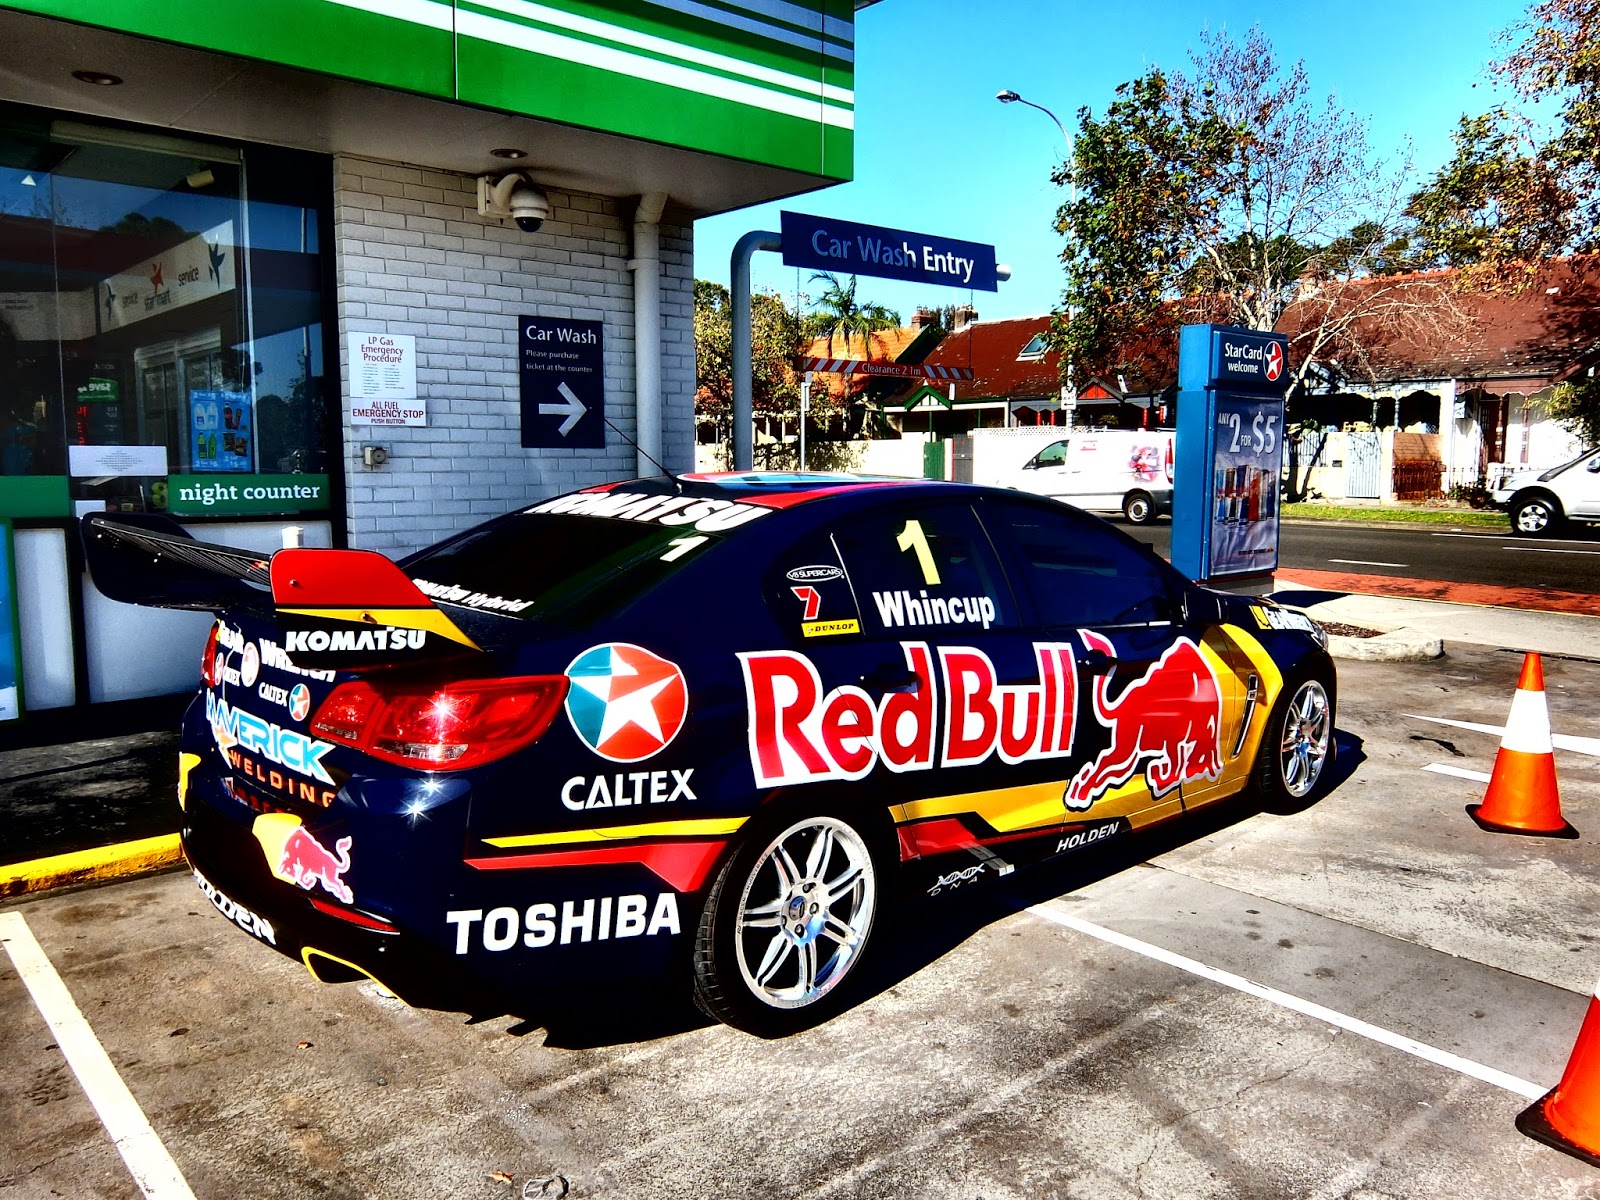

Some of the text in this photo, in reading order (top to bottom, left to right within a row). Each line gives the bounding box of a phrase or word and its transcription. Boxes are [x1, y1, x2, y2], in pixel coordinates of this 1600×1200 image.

[811, 228, 974, 283] Car Wash Entry
[178, 264, 199, 287] service
[368, 336, 394, 346] LP Gas
[525, 325, 597, 345] Car Wash
[361, 344, 404, 357] Emergency
[363, 353, 402, 364] Procedure
[526, 349, 580, 360] Please purchase
[1224, 342, 1263, 361] StarCard
[526, 363, 545, 371] ticket
[555, 364, 566, 372] the
[567, 365, 593, 373] counter
[861, 362, 901, 375] Clearance
[1227, 360, 1259, 373] welcome
[352, 408, 424, 419] EMERGENCY STOP
[371, 401, 399, 410] ALL FUEL
[1217, 412, 1230, 425] ANY
[1229, 412, 1241, 453] 2
[1240, 434, 1252, 447] FOR
[179, 482, 321, 506] night counter
[523, 492, 773, 532] KOMATSU
[660, 536, 709, 563] 1
[896, 519, 942, 586] 1
[799, 568, 841, 579] SUPERCARS
[461, 592, 535, 613] Hybrid
[872, 589, 996, 630] Whincup
[286, 626, 426, 653] KOMATSU
[814, 623, 854, 633] DUNLOP
[258, 681, 289, 707] CALTEX
[735, 640, 1078, 789] Red Bull
[205, 687, 337, 787] MAVERICK
[560, 768, 698, 811] CALTEX
[1055, 821, 1120, 853] HOLDEN
[446, 892, 682, 955] TOSHIBA
